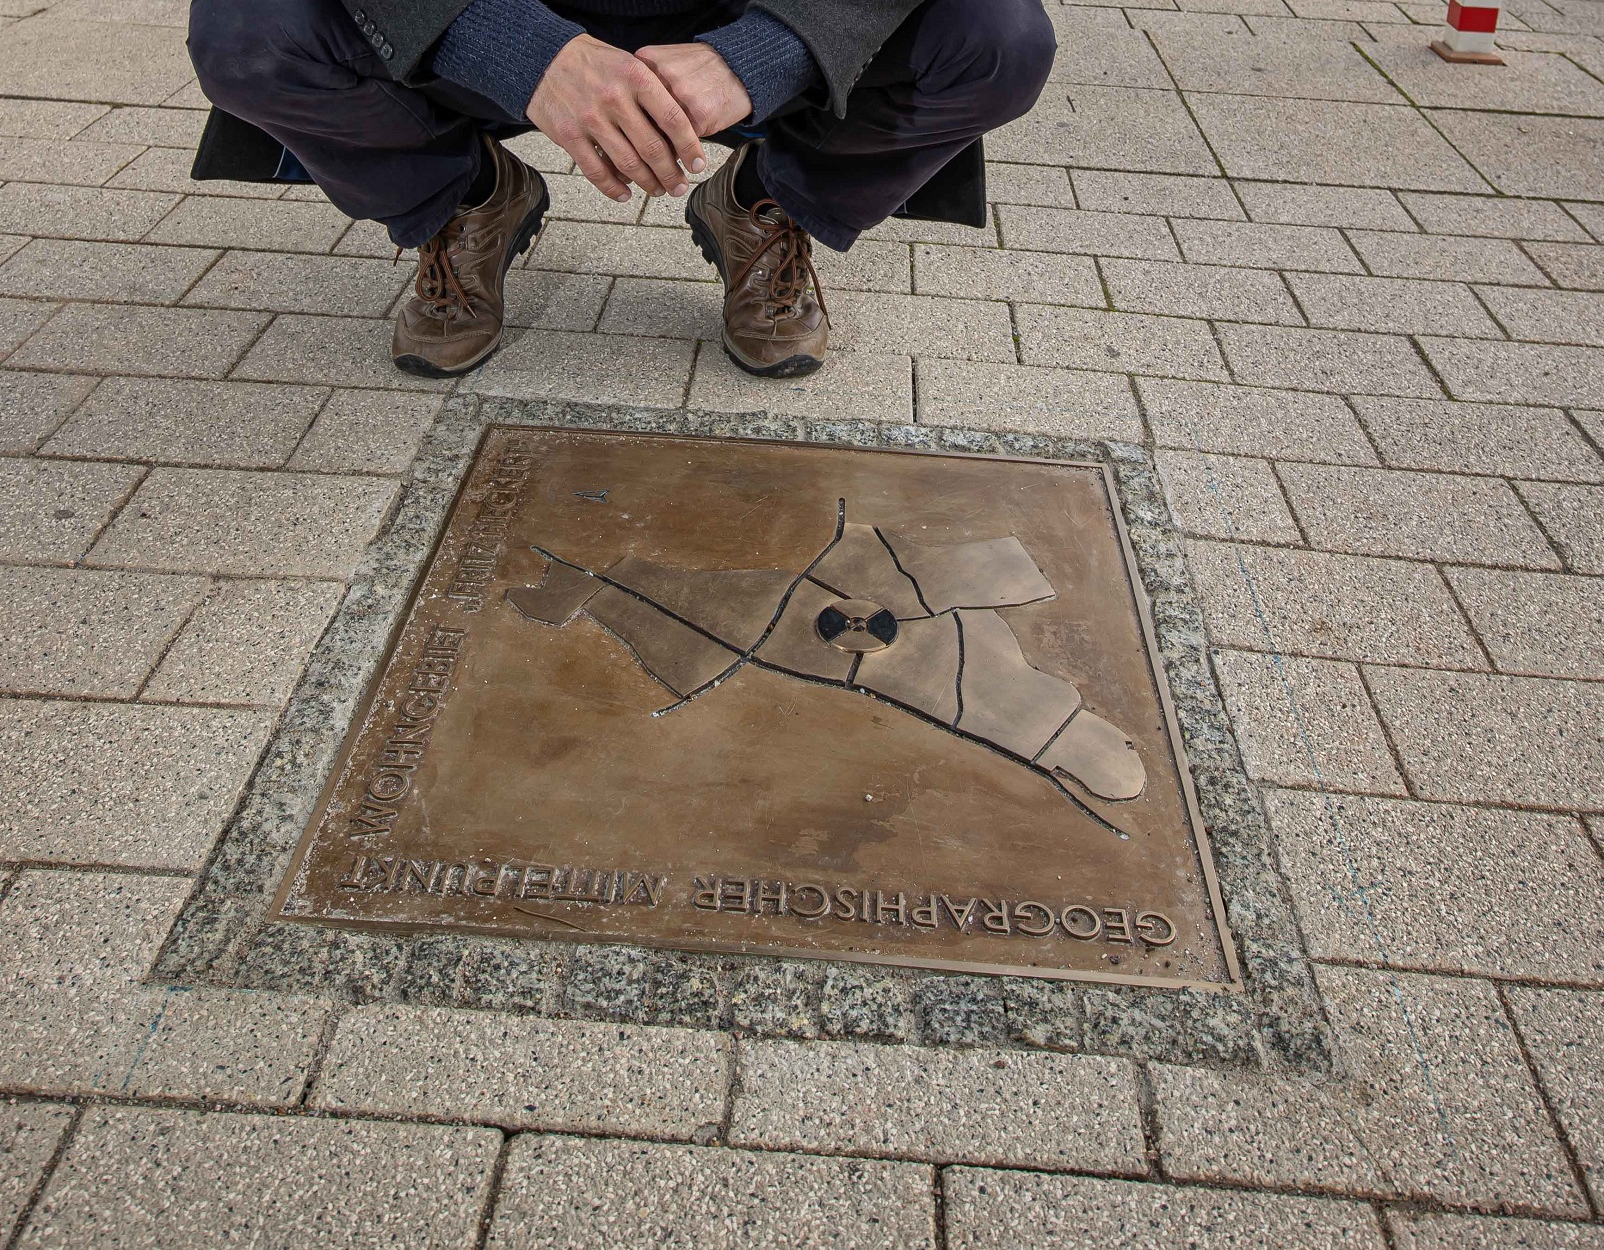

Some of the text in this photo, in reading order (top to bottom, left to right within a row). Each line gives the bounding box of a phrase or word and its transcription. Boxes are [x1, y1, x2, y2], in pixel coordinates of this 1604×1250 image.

[350, 626, 468, 838] WOHNGEBIET
[338, 855, 1177, 947] GEOGRAPHISCHER MITTELPUNKT
